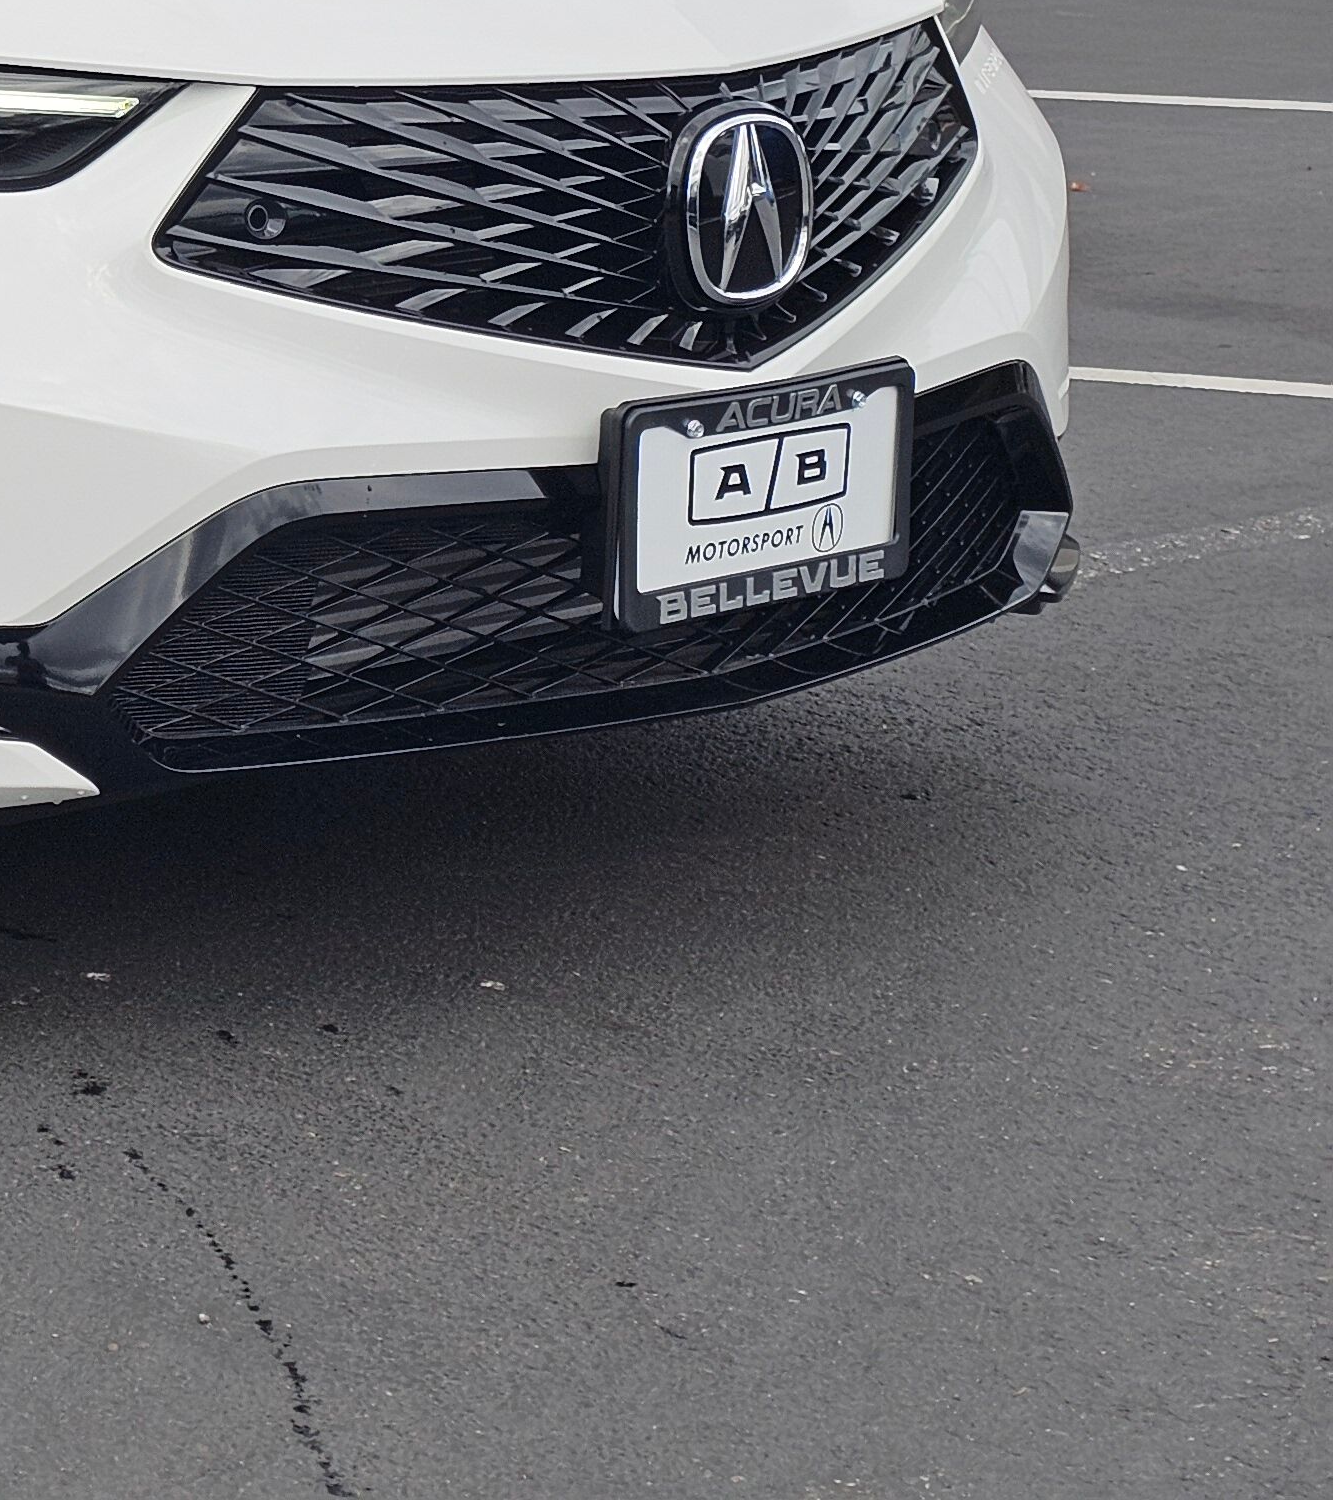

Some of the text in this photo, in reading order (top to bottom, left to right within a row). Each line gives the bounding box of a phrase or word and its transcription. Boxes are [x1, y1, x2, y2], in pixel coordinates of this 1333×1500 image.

[715, 384, 843, 433] ACURA
[715, 449, 827, 500] A B
[685, 525, 804, 565] MOTORSPORT
[656, 550, 885, 625] BELLEVUE
